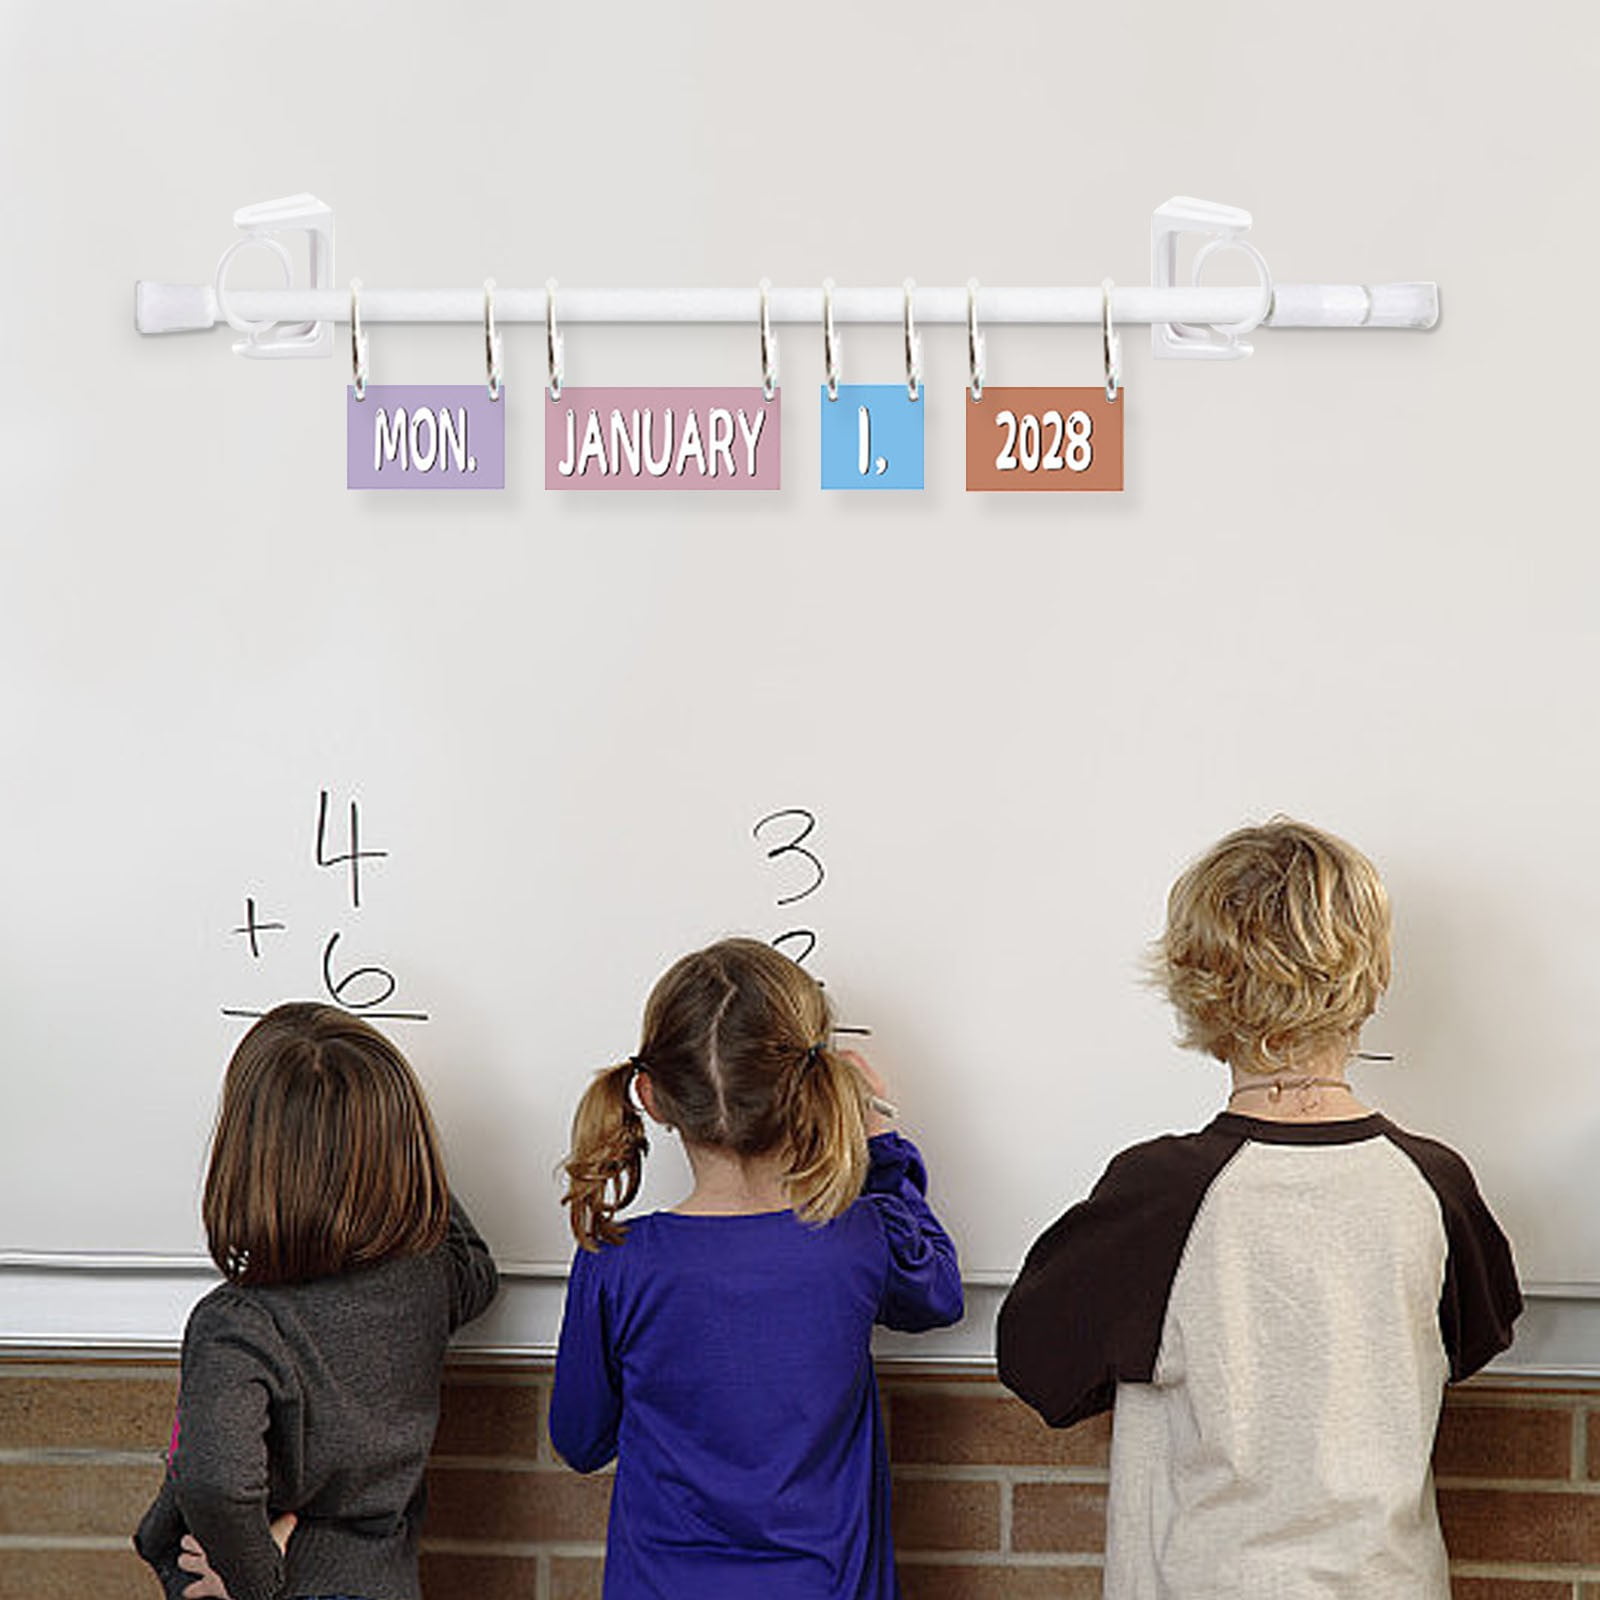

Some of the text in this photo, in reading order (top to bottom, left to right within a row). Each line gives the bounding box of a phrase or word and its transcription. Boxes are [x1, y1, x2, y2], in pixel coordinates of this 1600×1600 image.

[373, 407, 478, 473] MON.
[558, 408, 766, 478] JANUARY
[994, 410, 1094, 472] 2028
[316, 790, 388, 907] 4
[753, 808, 824, 905] 3
[323, 932, 395, 1008] 6
